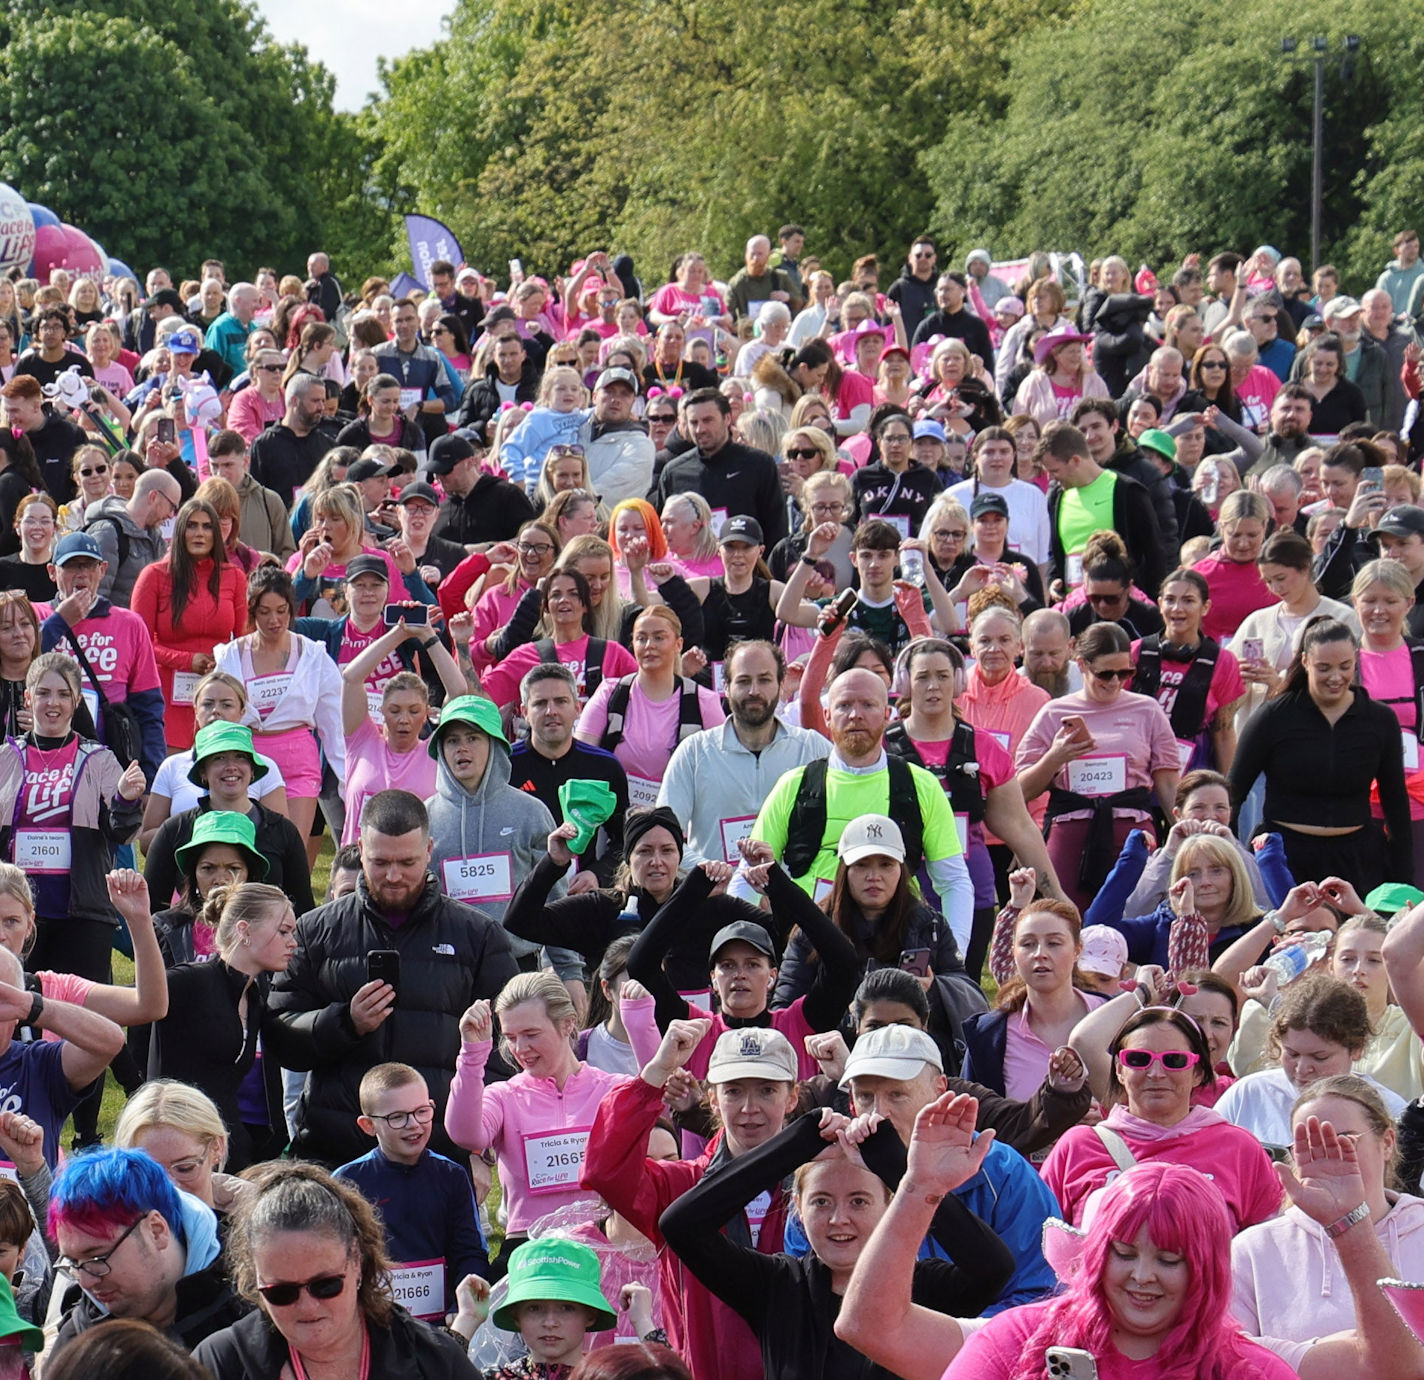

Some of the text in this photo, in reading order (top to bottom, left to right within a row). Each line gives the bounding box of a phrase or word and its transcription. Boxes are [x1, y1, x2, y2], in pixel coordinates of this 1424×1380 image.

[90, 631, 113, 646] for
[1080, 771, 1113, 783] 20423
[26, 777, 71, 815] Lif
[867, 823, 883, 838] NY
[31, 845, 60, 856] 21601
[460, 865, 495, 878] 5825
[740, 1036, 761, 1056] LA
[540, 1139, 562, 1149] Tricia
[527, 1256, 581, 1270] ScottishPower
[419, 1270, 433, 1279] Ryan
[394, 1285, 430, 1300] 21666
